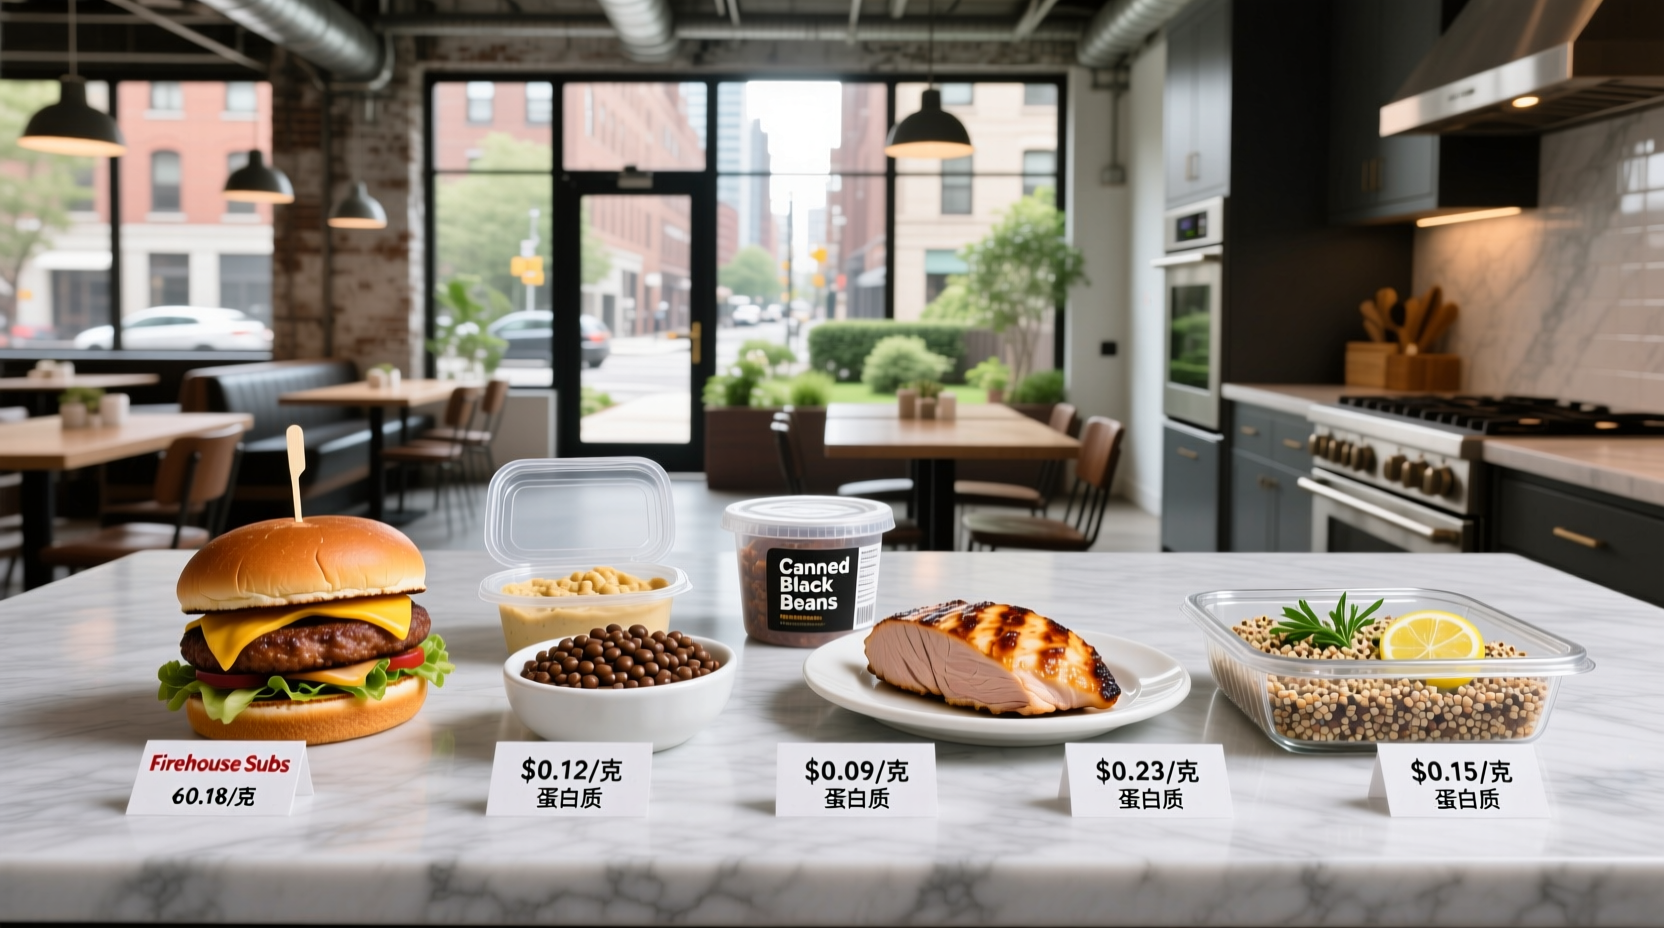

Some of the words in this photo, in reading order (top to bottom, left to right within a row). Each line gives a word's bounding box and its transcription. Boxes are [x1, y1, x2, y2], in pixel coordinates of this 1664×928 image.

[779, 556, 850, 575] Canned
[780, 576, 833, 593] Black
[780, 594, 838, 611] Beans
[149, 754, 242, 772] Firehouse
[244, 755, 291, 773] Subs
[521, 756, 623, 784] $0.12/克
[805, 757, 909, 785] $0.09/克
[1096, 757, 1200, 785] $0.23/克
[1411, 758, 1513, 785] $0.15/克
[172, 786, 257, 807] 60.18/克
[536, 787, 603, 809] 蛋白质
[824, 787, 890, 809] 蛋白质
[1118, 788, 1184, 810] 蛋白质
[1435, 788, 1501, 810] 蛋白质
